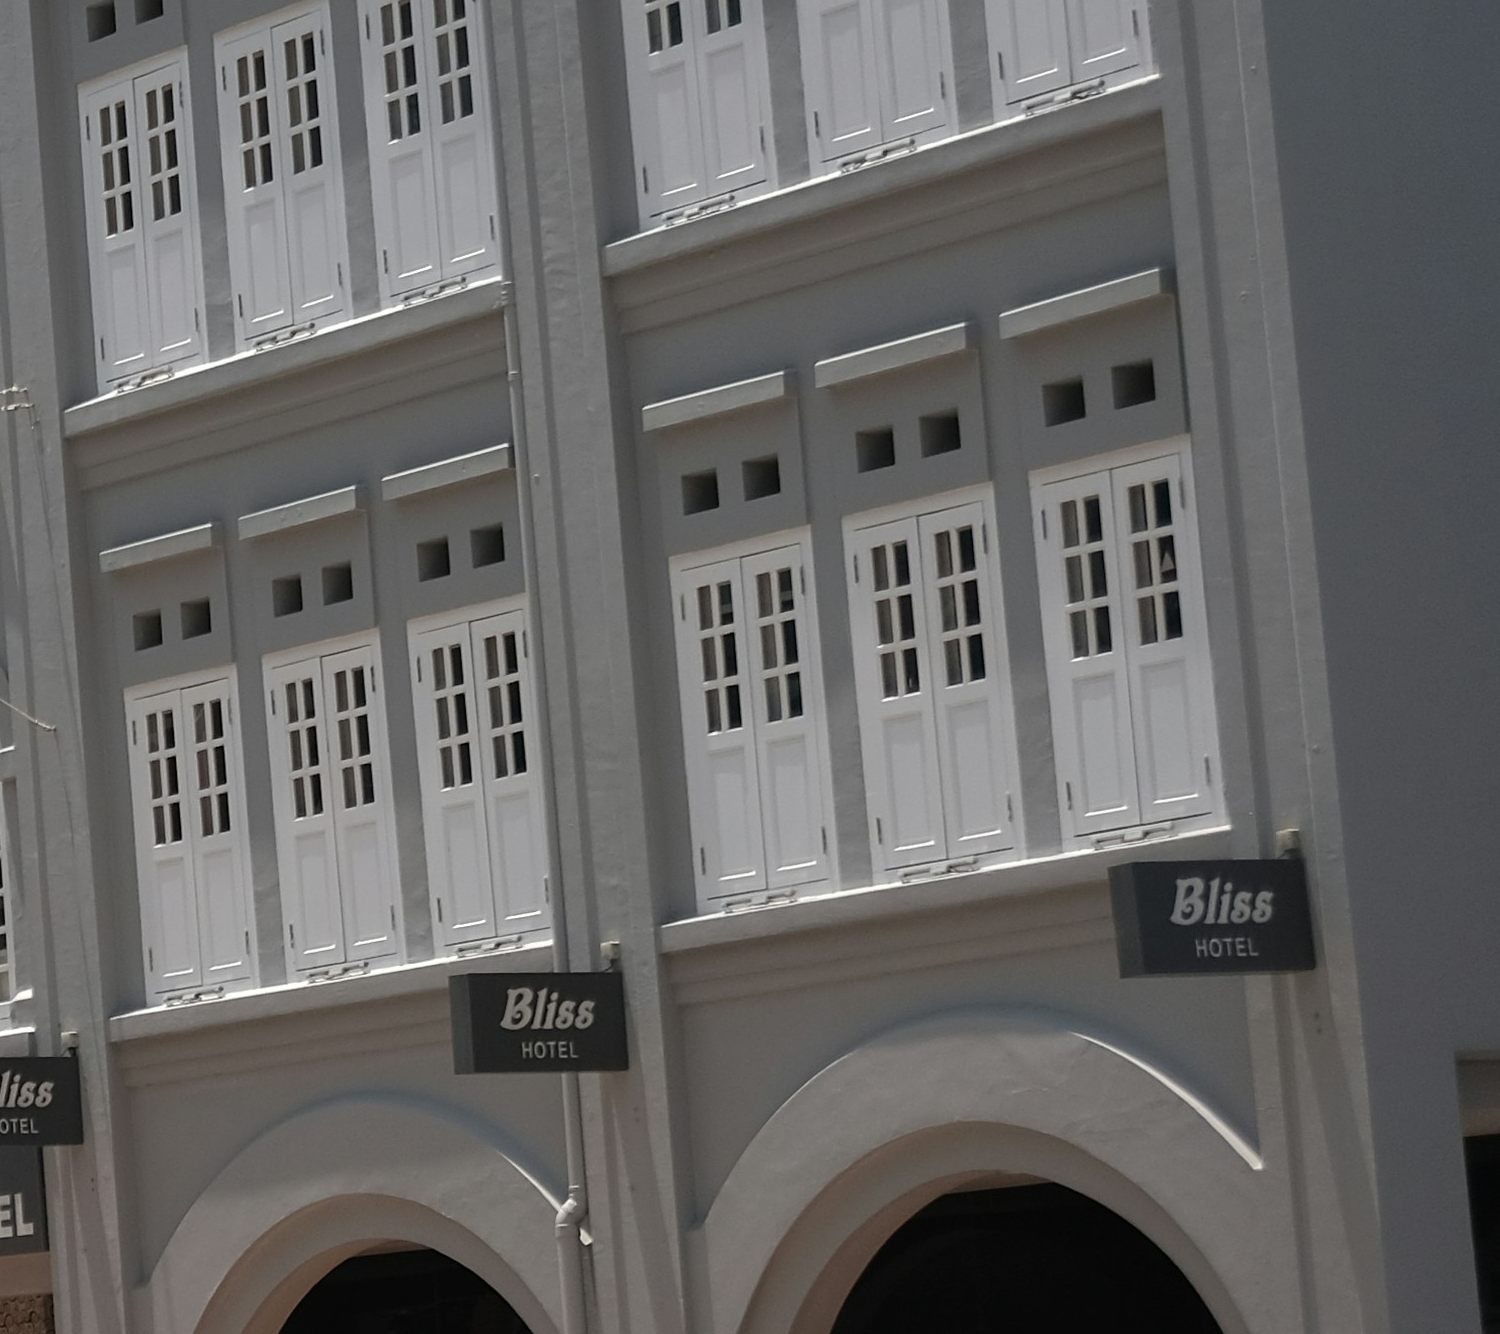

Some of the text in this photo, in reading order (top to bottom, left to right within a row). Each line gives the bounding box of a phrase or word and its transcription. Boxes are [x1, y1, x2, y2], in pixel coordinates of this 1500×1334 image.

[1169, 876, 1275, 926] Bliss
[1194, 937, 1260, 958] HOTEL
[500, 987, 596, 1031] Bliss
[521, 1041, 579, 1060] HOTEL
